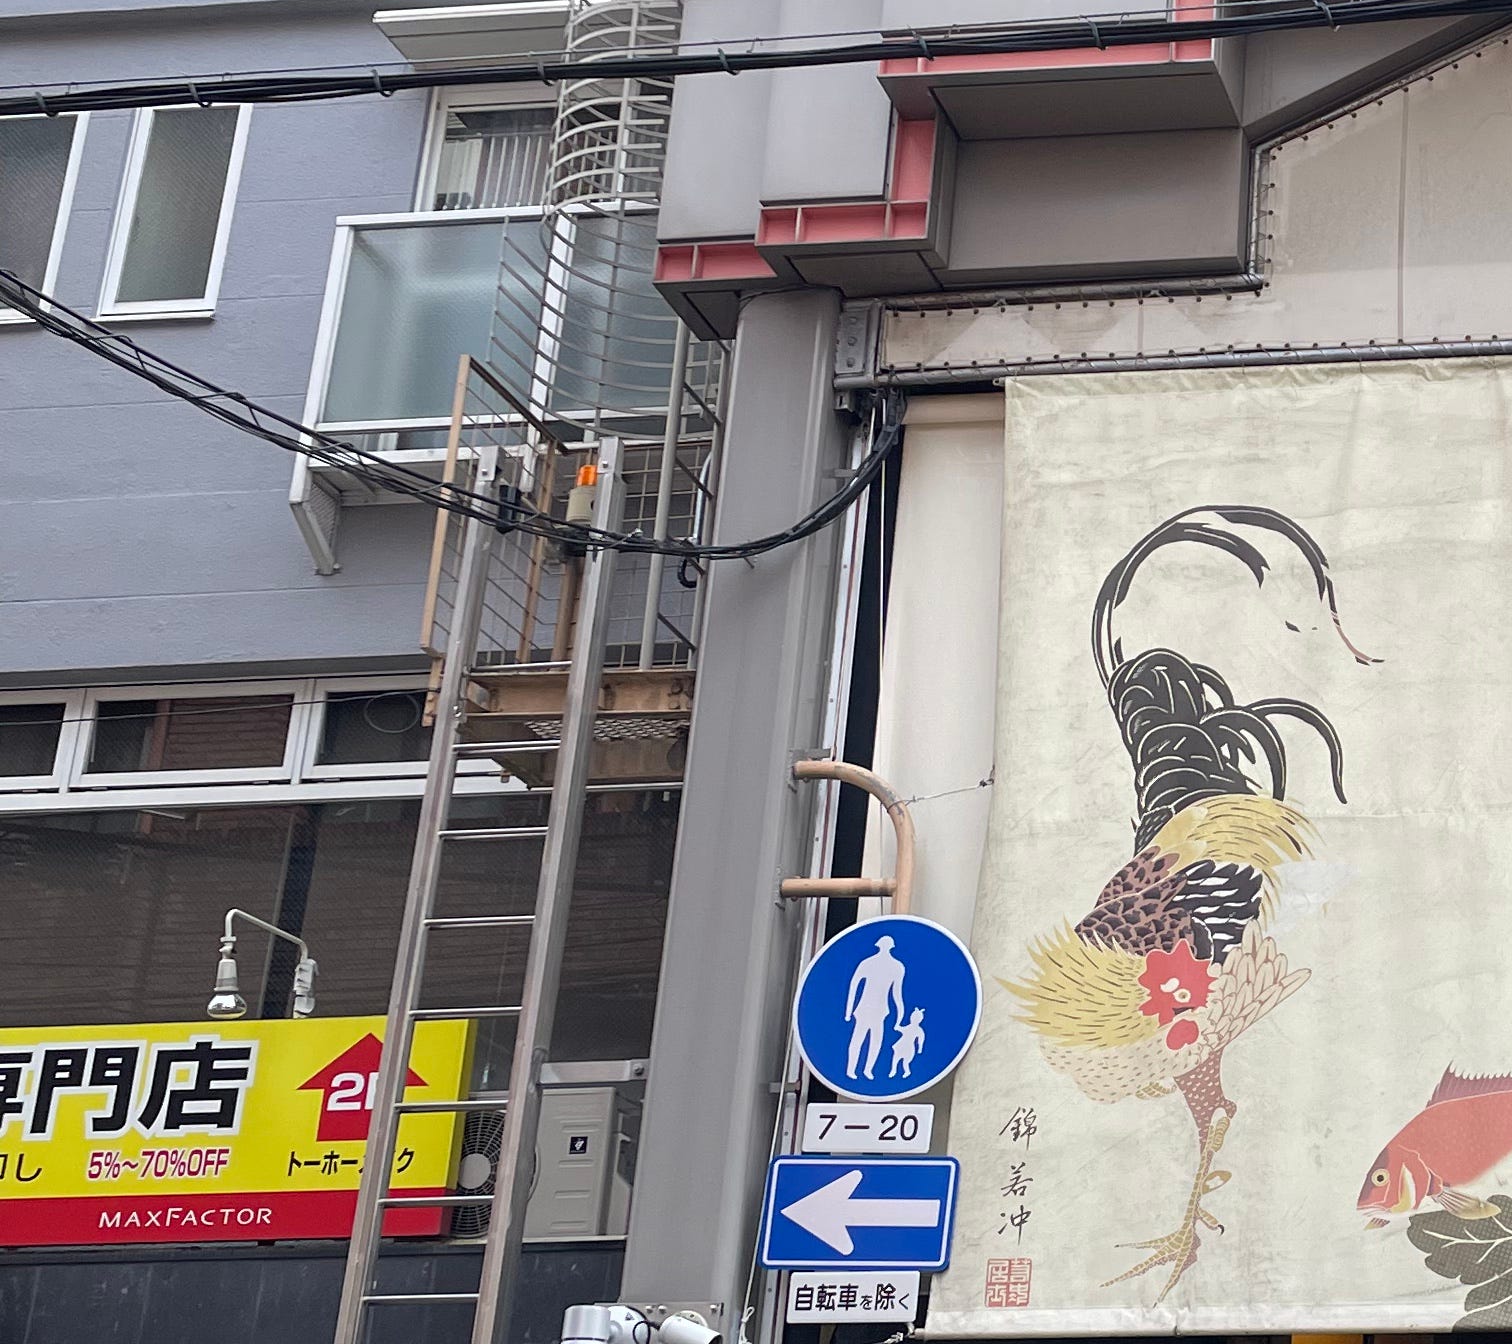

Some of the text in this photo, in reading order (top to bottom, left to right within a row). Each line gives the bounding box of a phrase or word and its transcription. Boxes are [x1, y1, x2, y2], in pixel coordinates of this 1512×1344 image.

[0, 1152, 43, 1182] し
[794, 1283, 911, 1312] 自転車を除く
